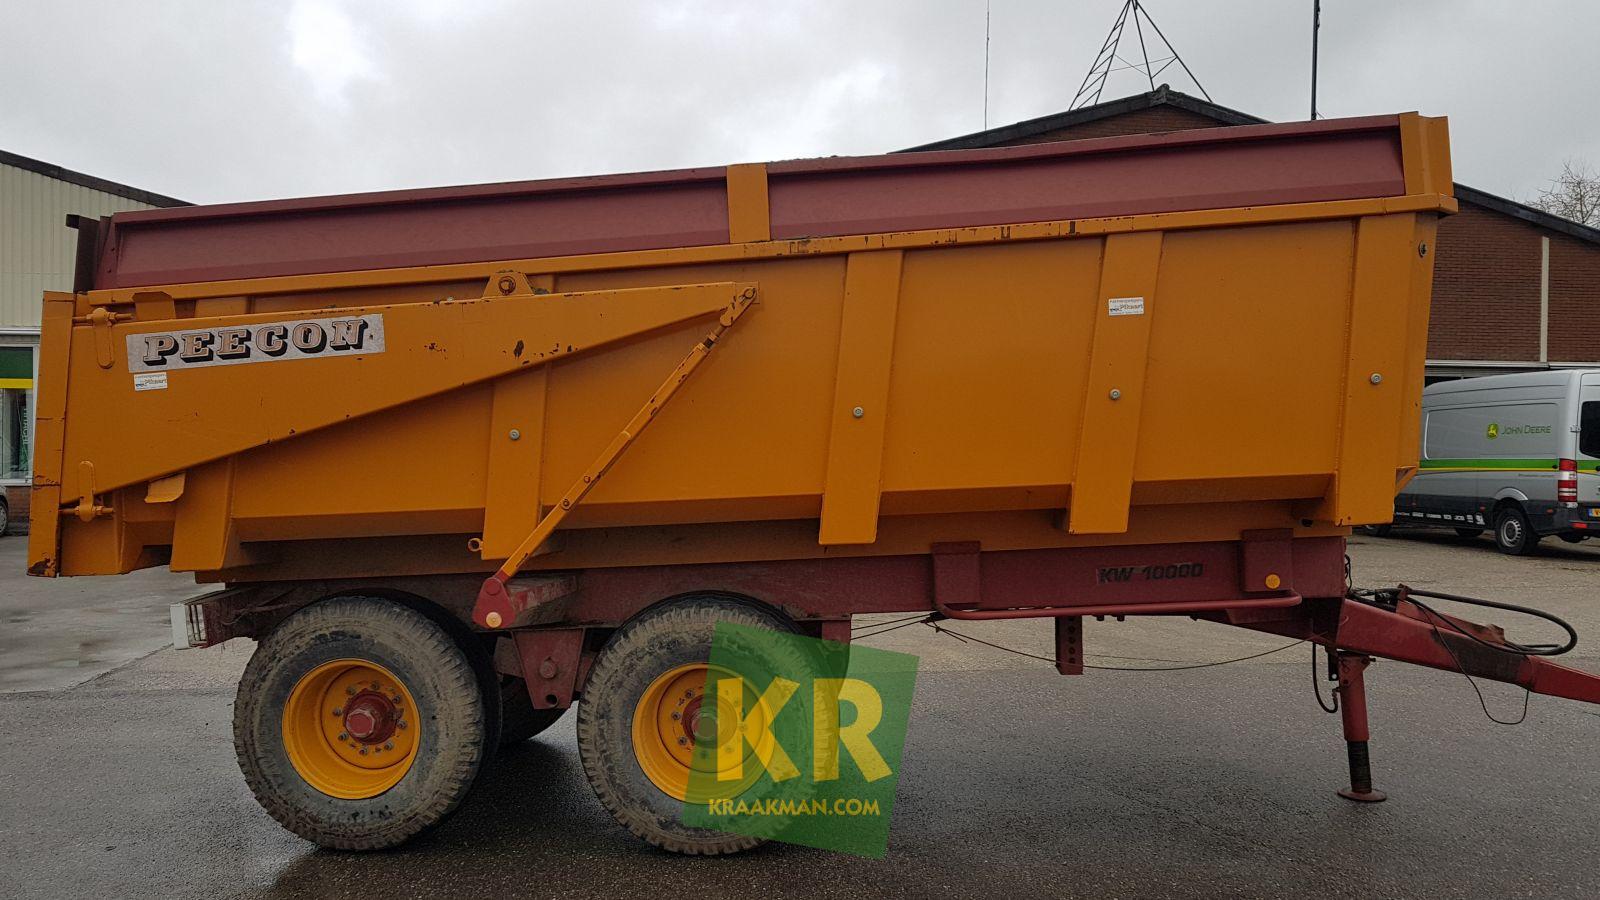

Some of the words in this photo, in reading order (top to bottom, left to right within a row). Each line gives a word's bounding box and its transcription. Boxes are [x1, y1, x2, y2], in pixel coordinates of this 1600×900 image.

[143, 318, 369, 366] PEECON
[1501, 426, 1523, 435] JOHN
[1524, 425, 1552, 434] DEERE
[1099, 567, 1134, 584] KW
[1142, 563, 1204, 581] 10000
